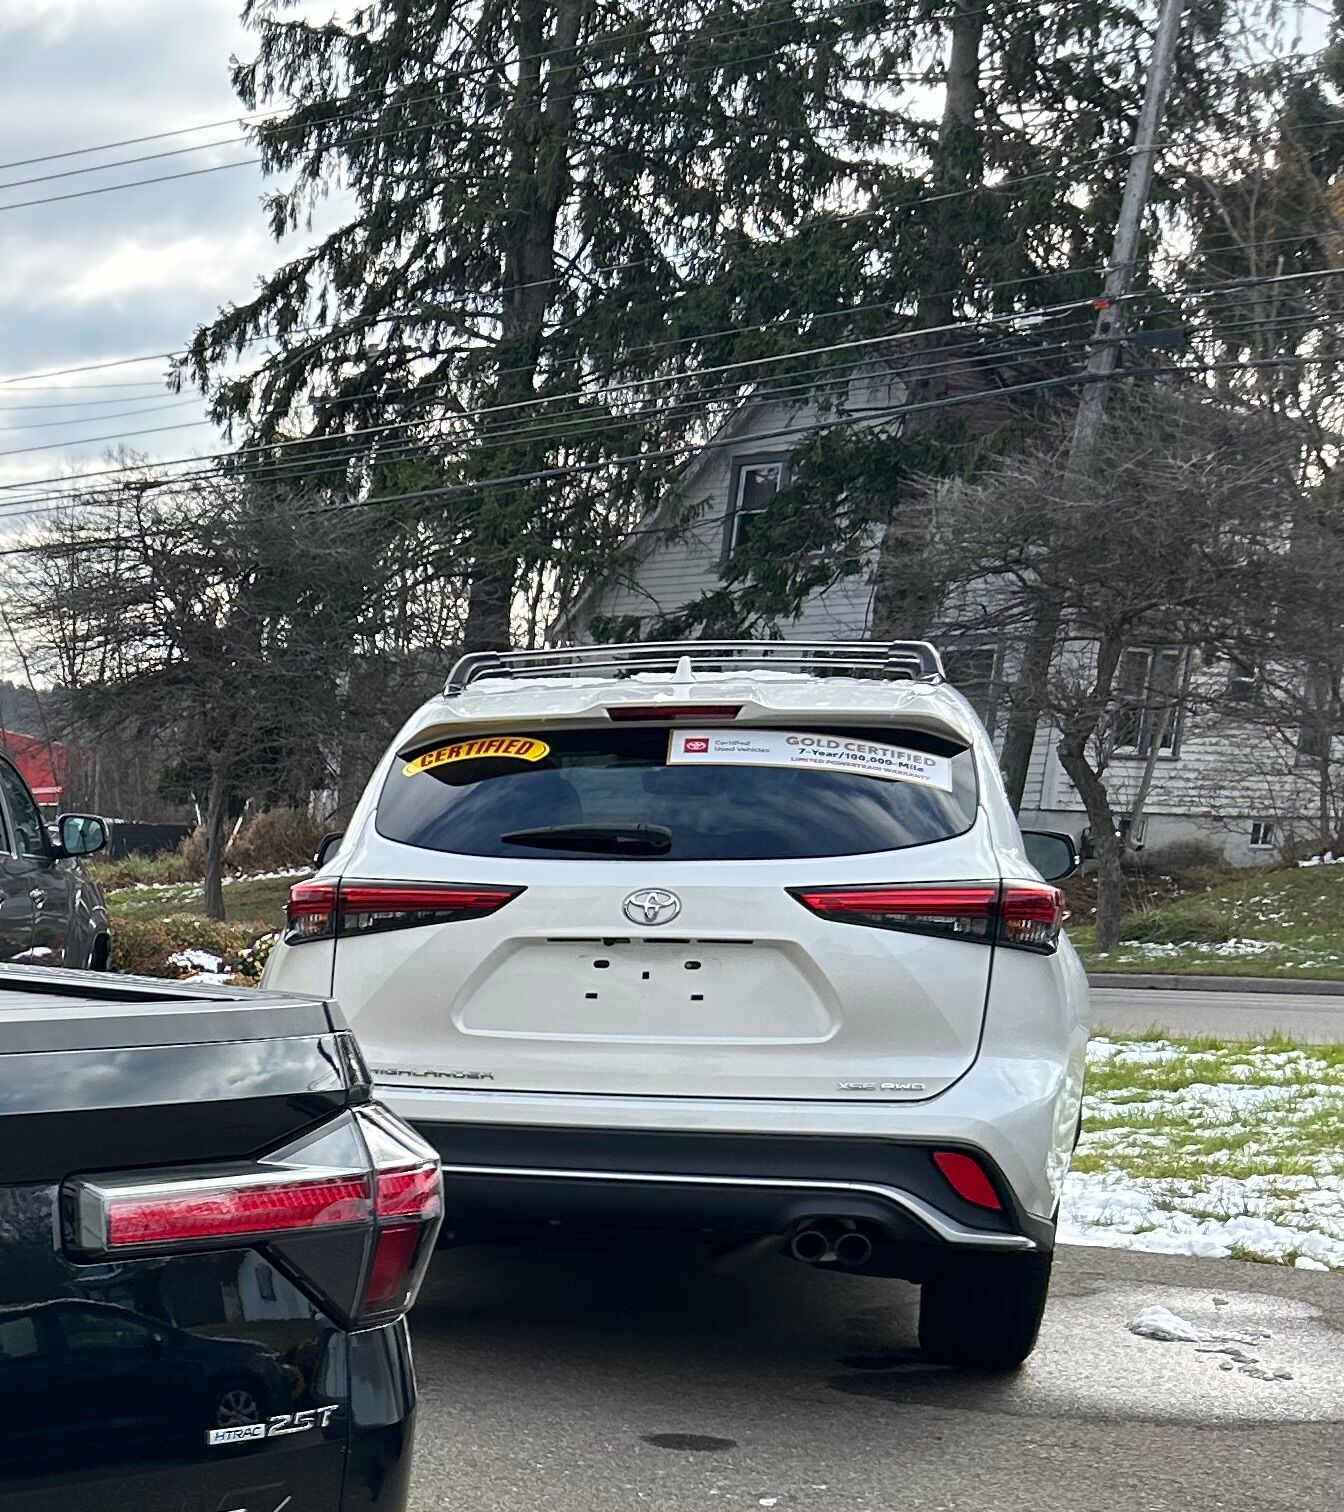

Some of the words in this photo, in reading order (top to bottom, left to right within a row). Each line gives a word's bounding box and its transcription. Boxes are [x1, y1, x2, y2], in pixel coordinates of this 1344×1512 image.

[420, 739, 535, 768] CERTIFIED
[785, 736, 840, 750] GOLD
[843, 742, 937, 767] CERTIFIED
[215, 1426, 261, 1441] HTRAC
